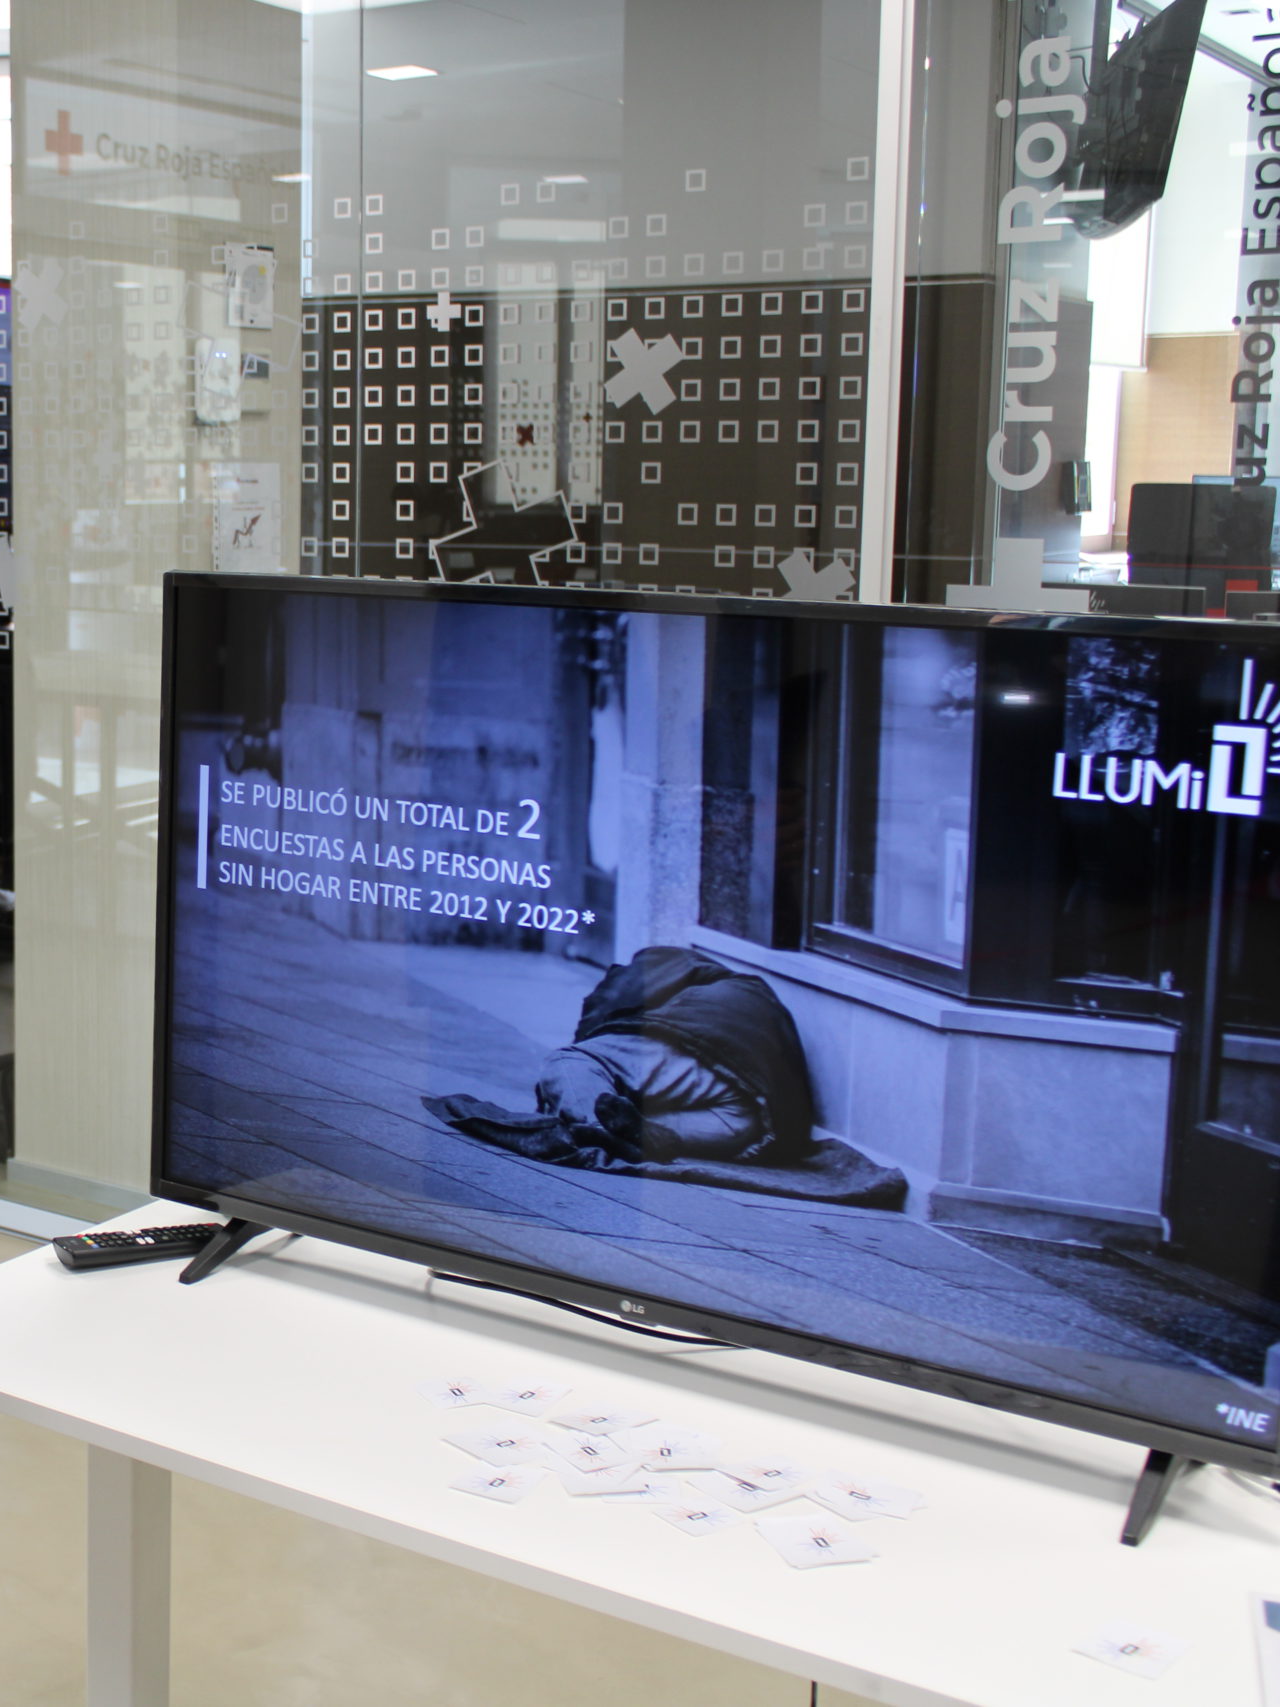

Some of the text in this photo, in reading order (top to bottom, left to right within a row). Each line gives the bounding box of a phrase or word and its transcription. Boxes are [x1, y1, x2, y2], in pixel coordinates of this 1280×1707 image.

[96, 133, 151, 169] Cruz
[155, 144, 202, 180] Roja
[987, 35, 1088, 491] Cruz Roja
[1231, 278, 1280, 403] Roja
[221, 781, 541, 840] SE PUBLICÓ UN TOTAL DE 2
[220, 824, 552, 889] ENCUESTAS A LAS PERSONAS
[218, 861, 254, 887] SIN
[261, 867, 342, 900] HOGAR
[348, 879, 423, 911] ENTRE
[429, 890, 489, 921] 2012
[495, 899, 513, 924] Y
[631, 1303, 645, 1315] LG
